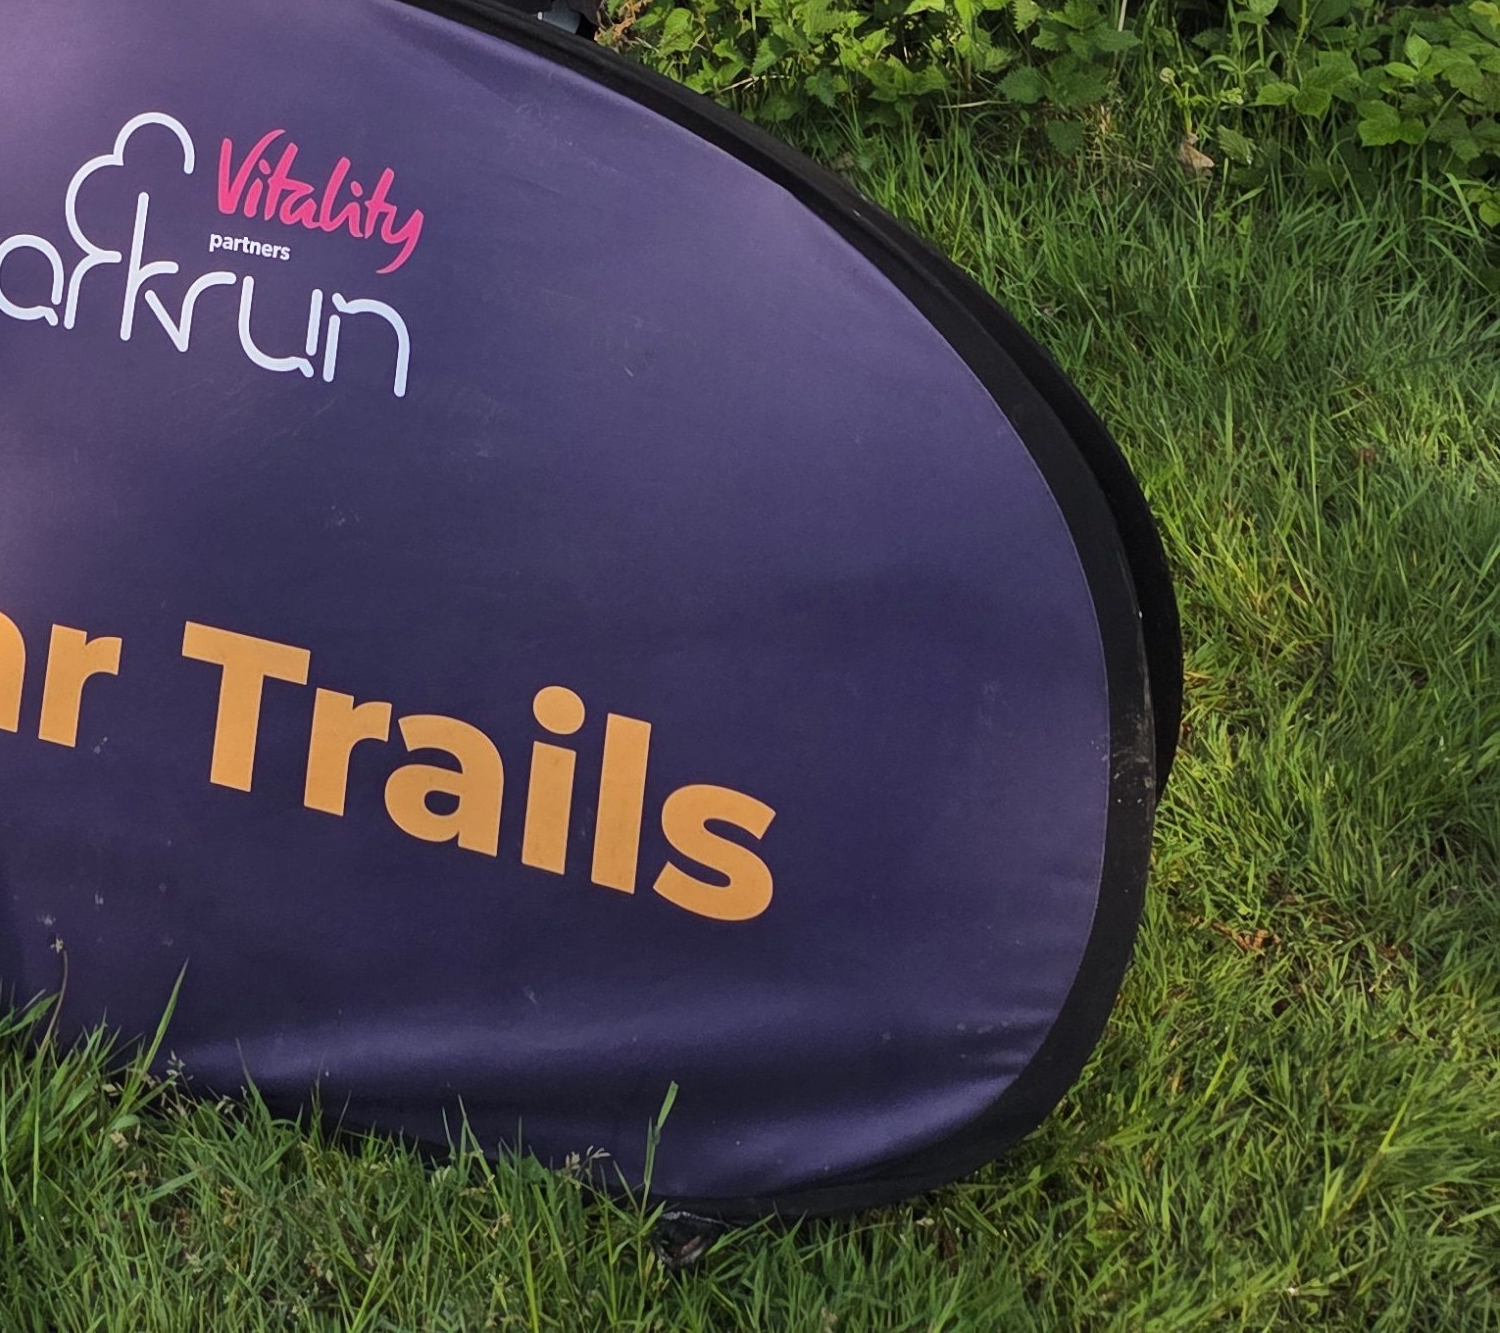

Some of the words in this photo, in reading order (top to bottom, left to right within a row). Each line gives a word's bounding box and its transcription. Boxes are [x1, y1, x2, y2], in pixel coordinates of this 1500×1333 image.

[209, 233, 291, 261] partners
[217, 129, 424, 274] Vitality
[182, 620, 777, 923] Trails
